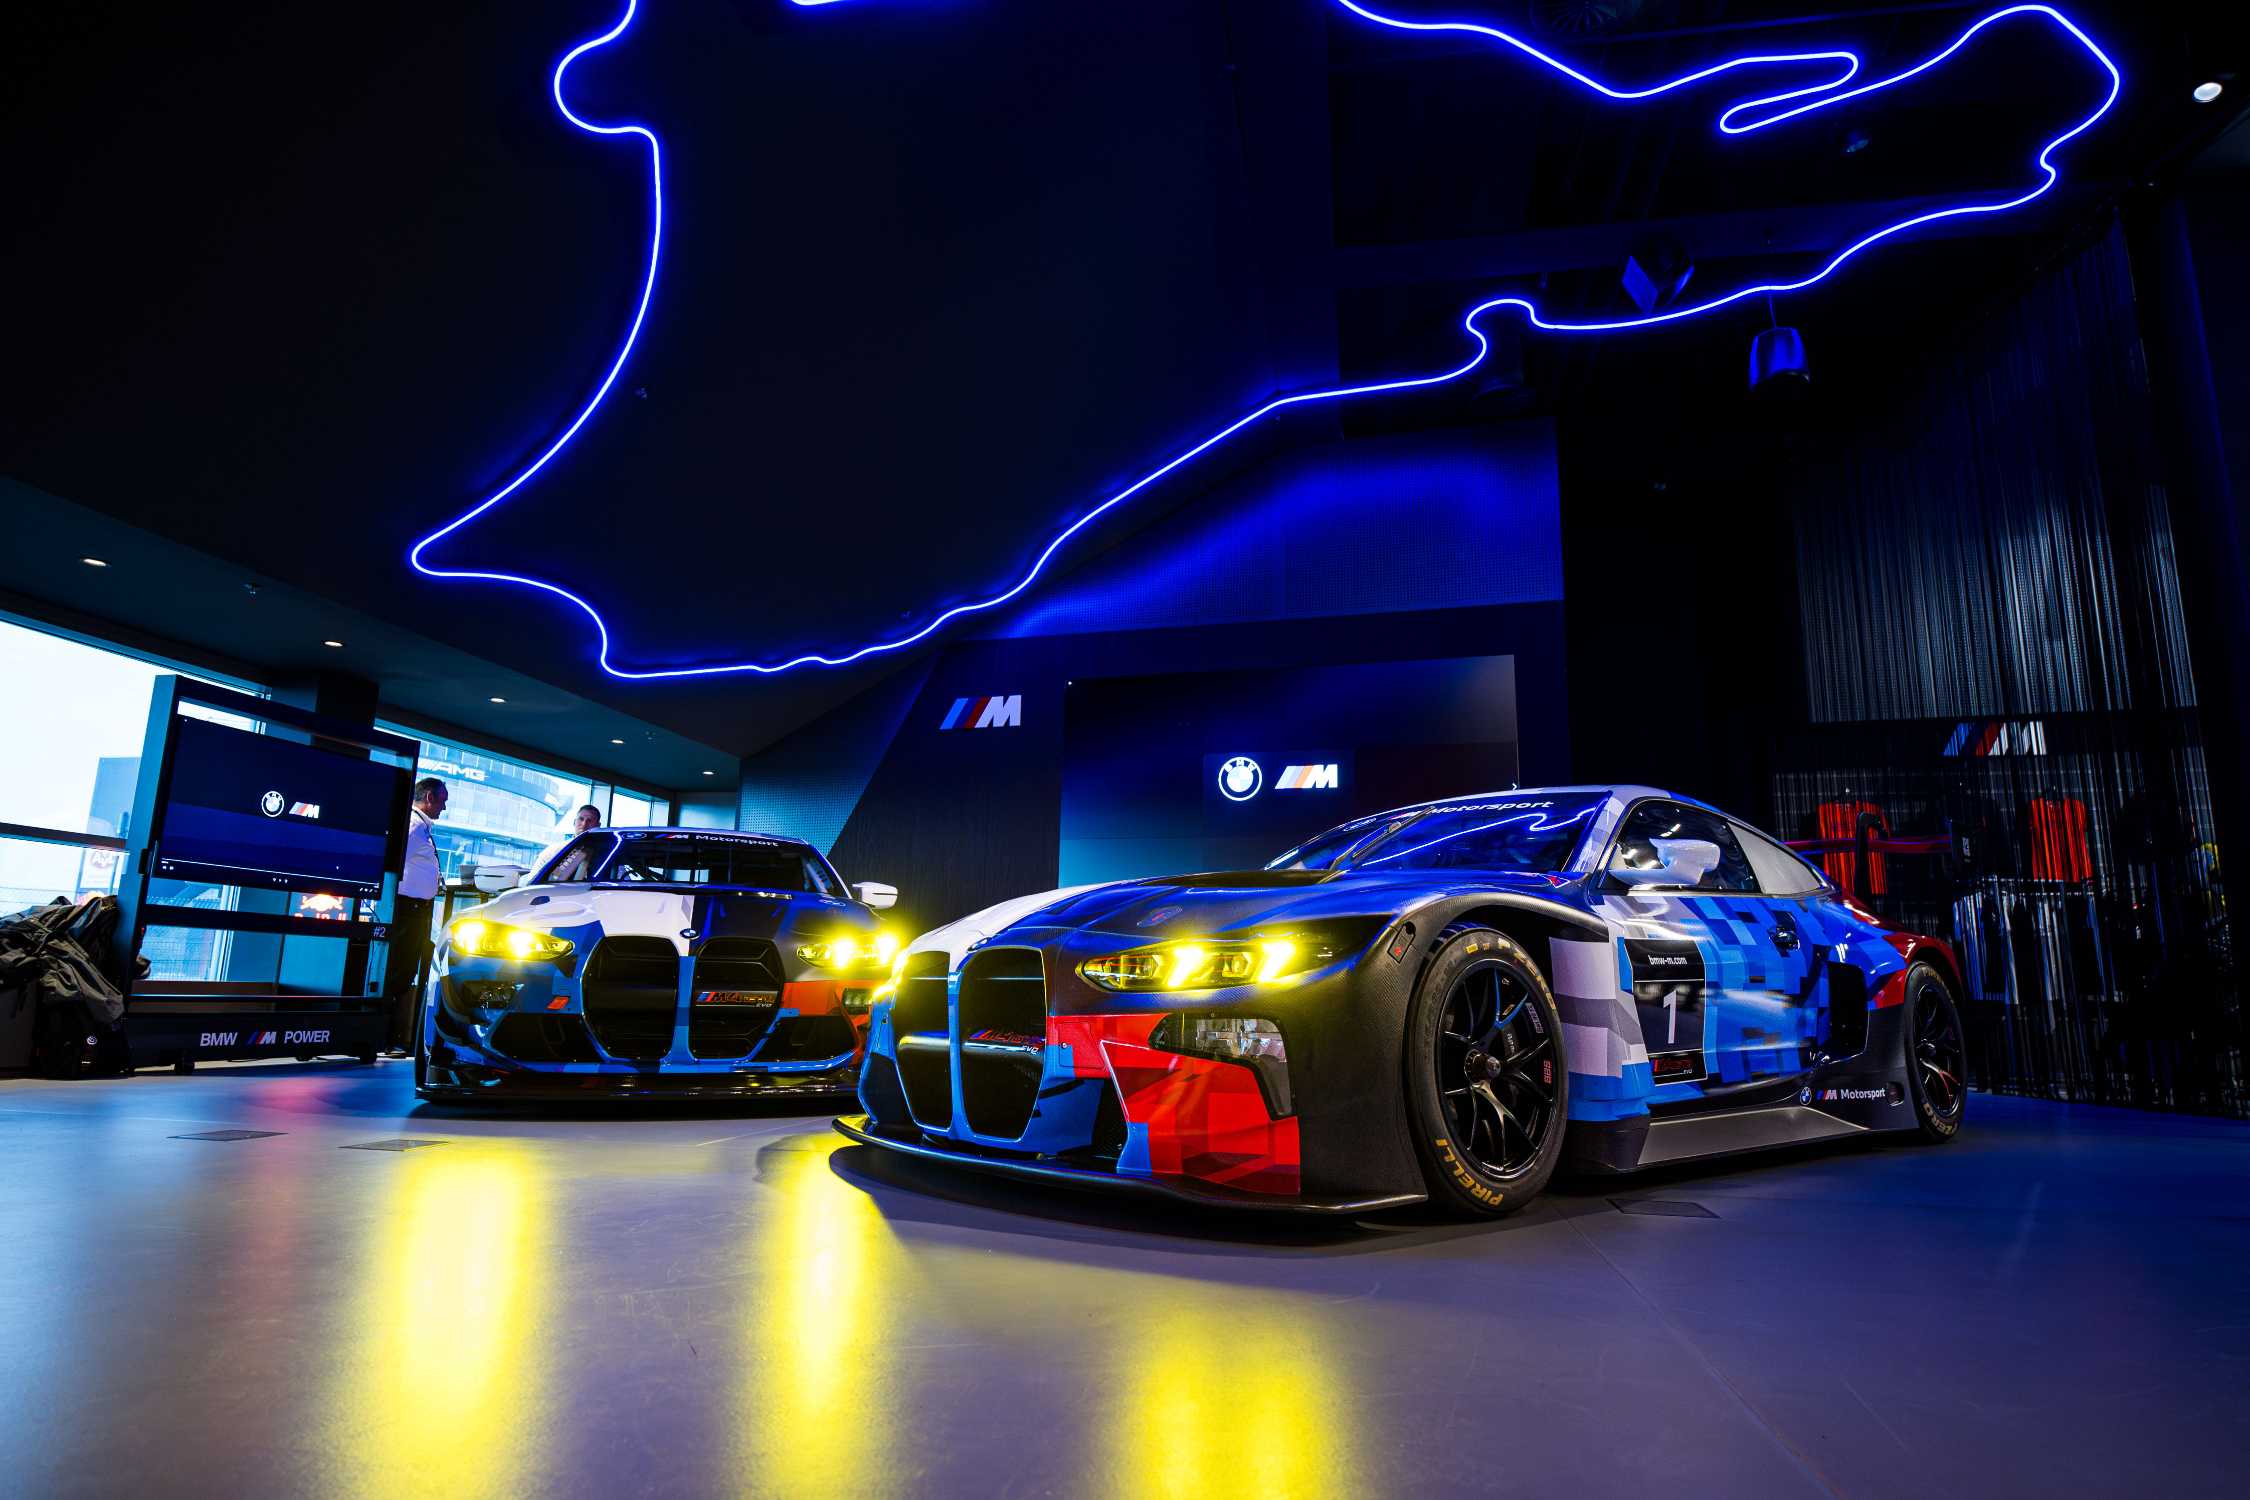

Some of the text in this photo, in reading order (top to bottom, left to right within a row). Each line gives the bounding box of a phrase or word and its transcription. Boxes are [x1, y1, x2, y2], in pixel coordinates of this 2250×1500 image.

[696, 834, 779, 847] Motorsport
[1663, 989, 1677, 1045] 1
[200, 1032, 238, 1047] BMW
[284, 1030, 330, 1044] POWER
[1841, 1087, 1886, 1100] Motorsport
[1435, 1138, 1504, 1207] PIRELLI
